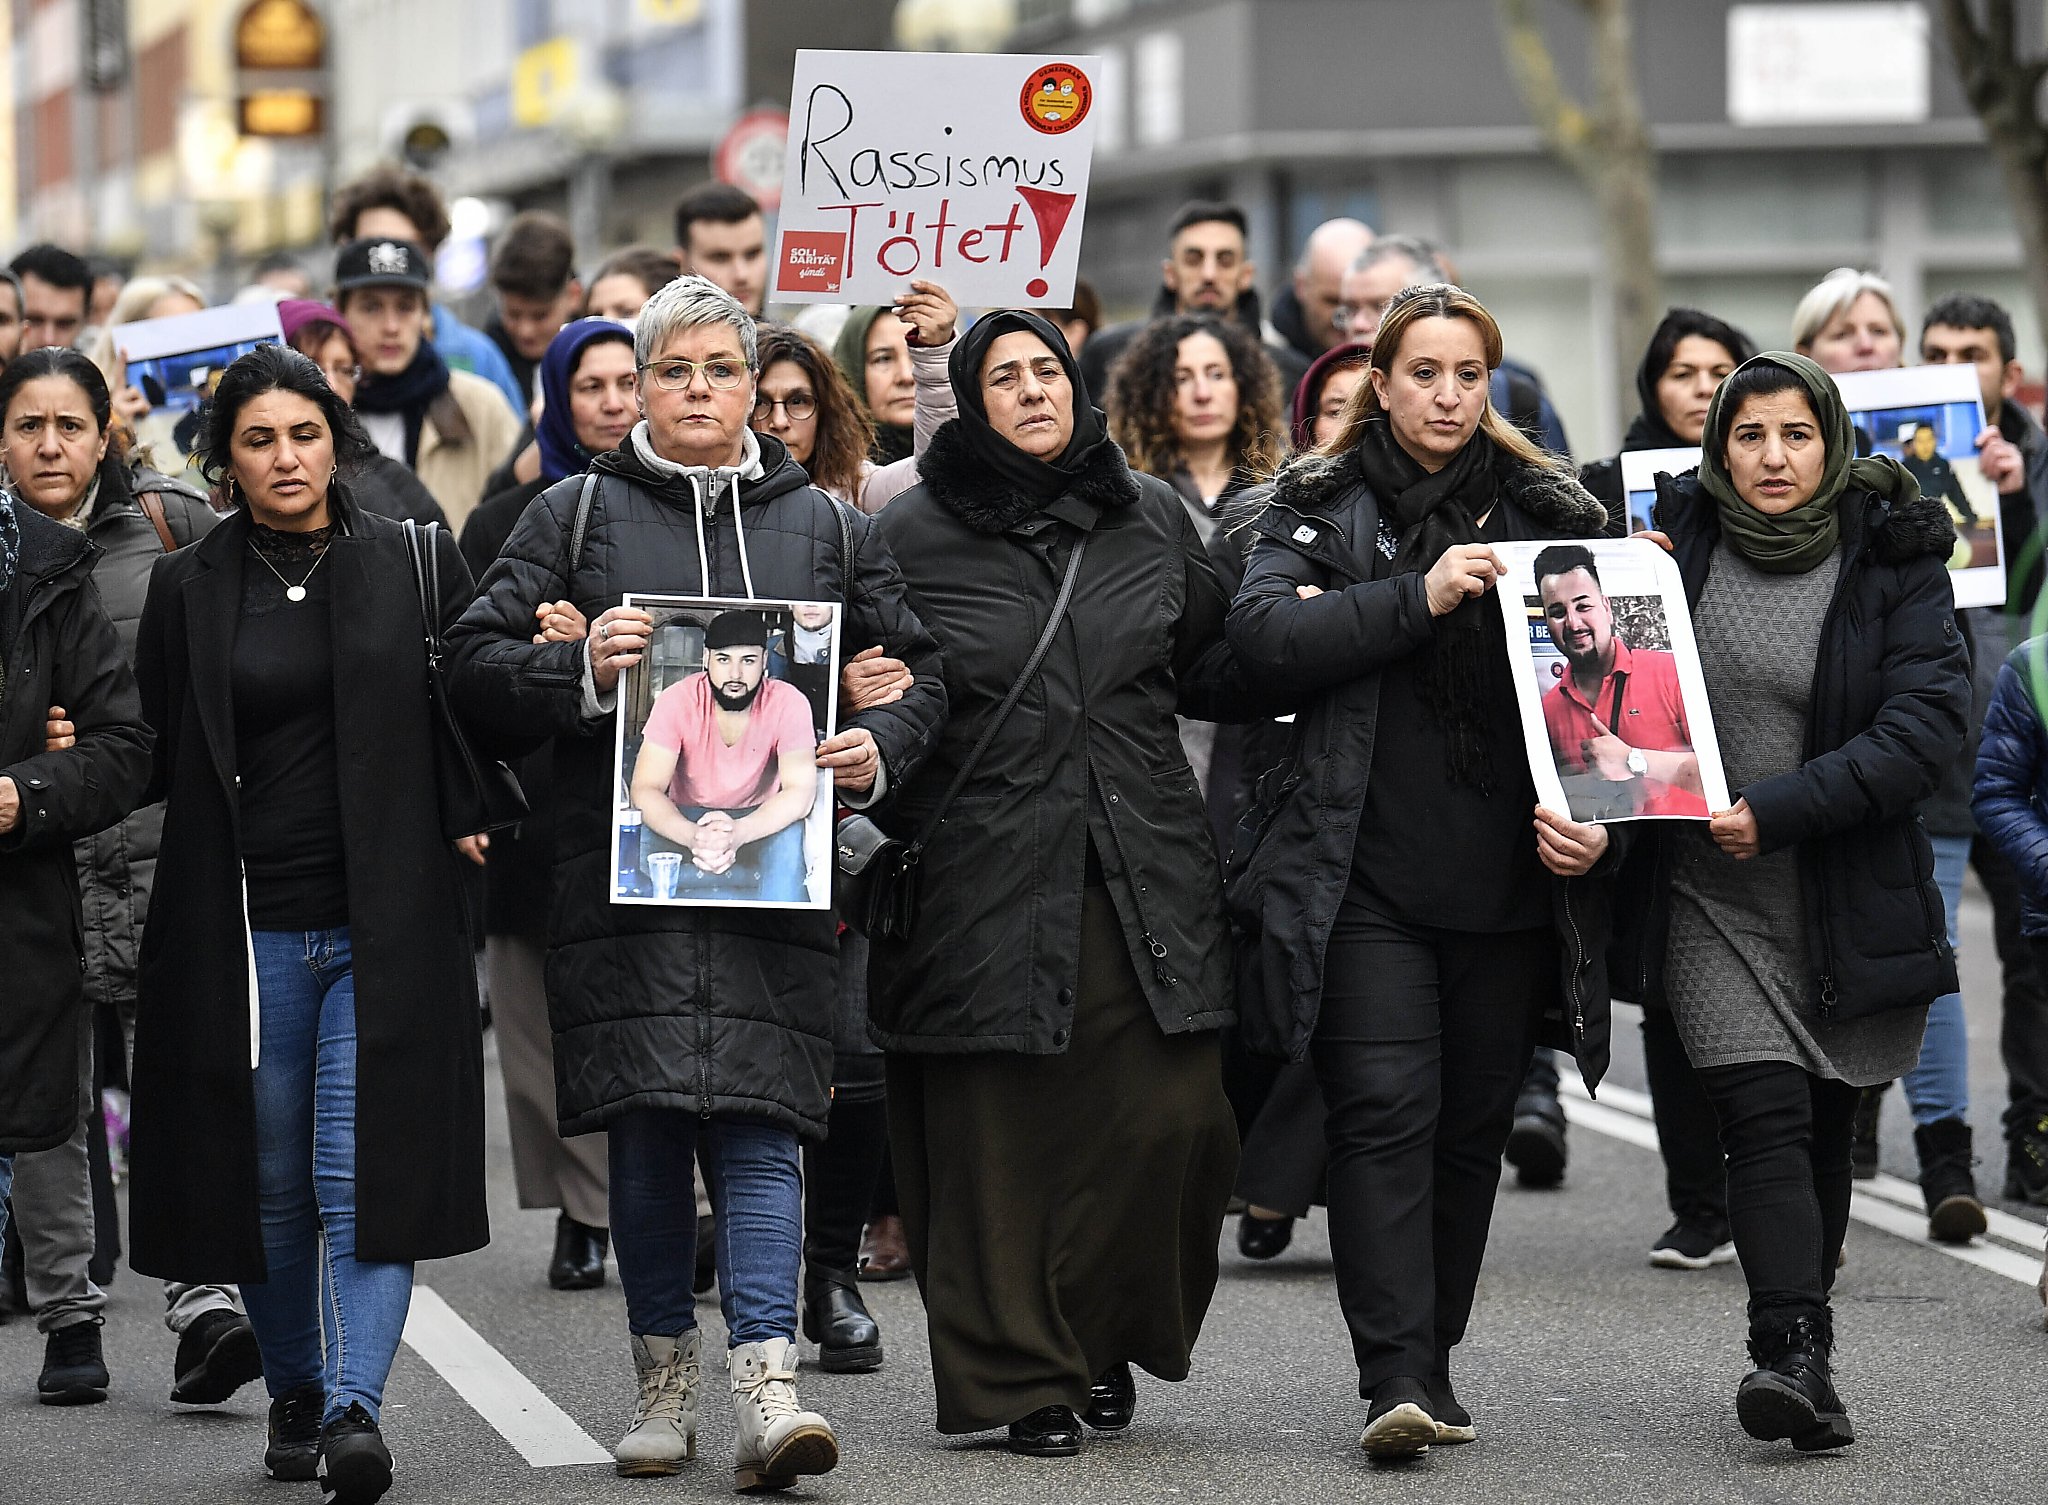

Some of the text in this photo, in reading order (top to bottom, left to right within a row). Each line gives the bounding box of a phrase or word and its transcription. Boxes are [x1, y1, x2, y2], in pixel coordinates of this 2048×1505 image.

[1039, 67, 1081, 80] GEMEINSAM
[1023, 83, 1034, 105] GEGEN
[801, 84, 1064, 199] Rassismus
[817, 185, 1077, 298] Tötet!
[789, 254, 838, 265] DARITÄT
[790, 247, 817, 256] SOLI
